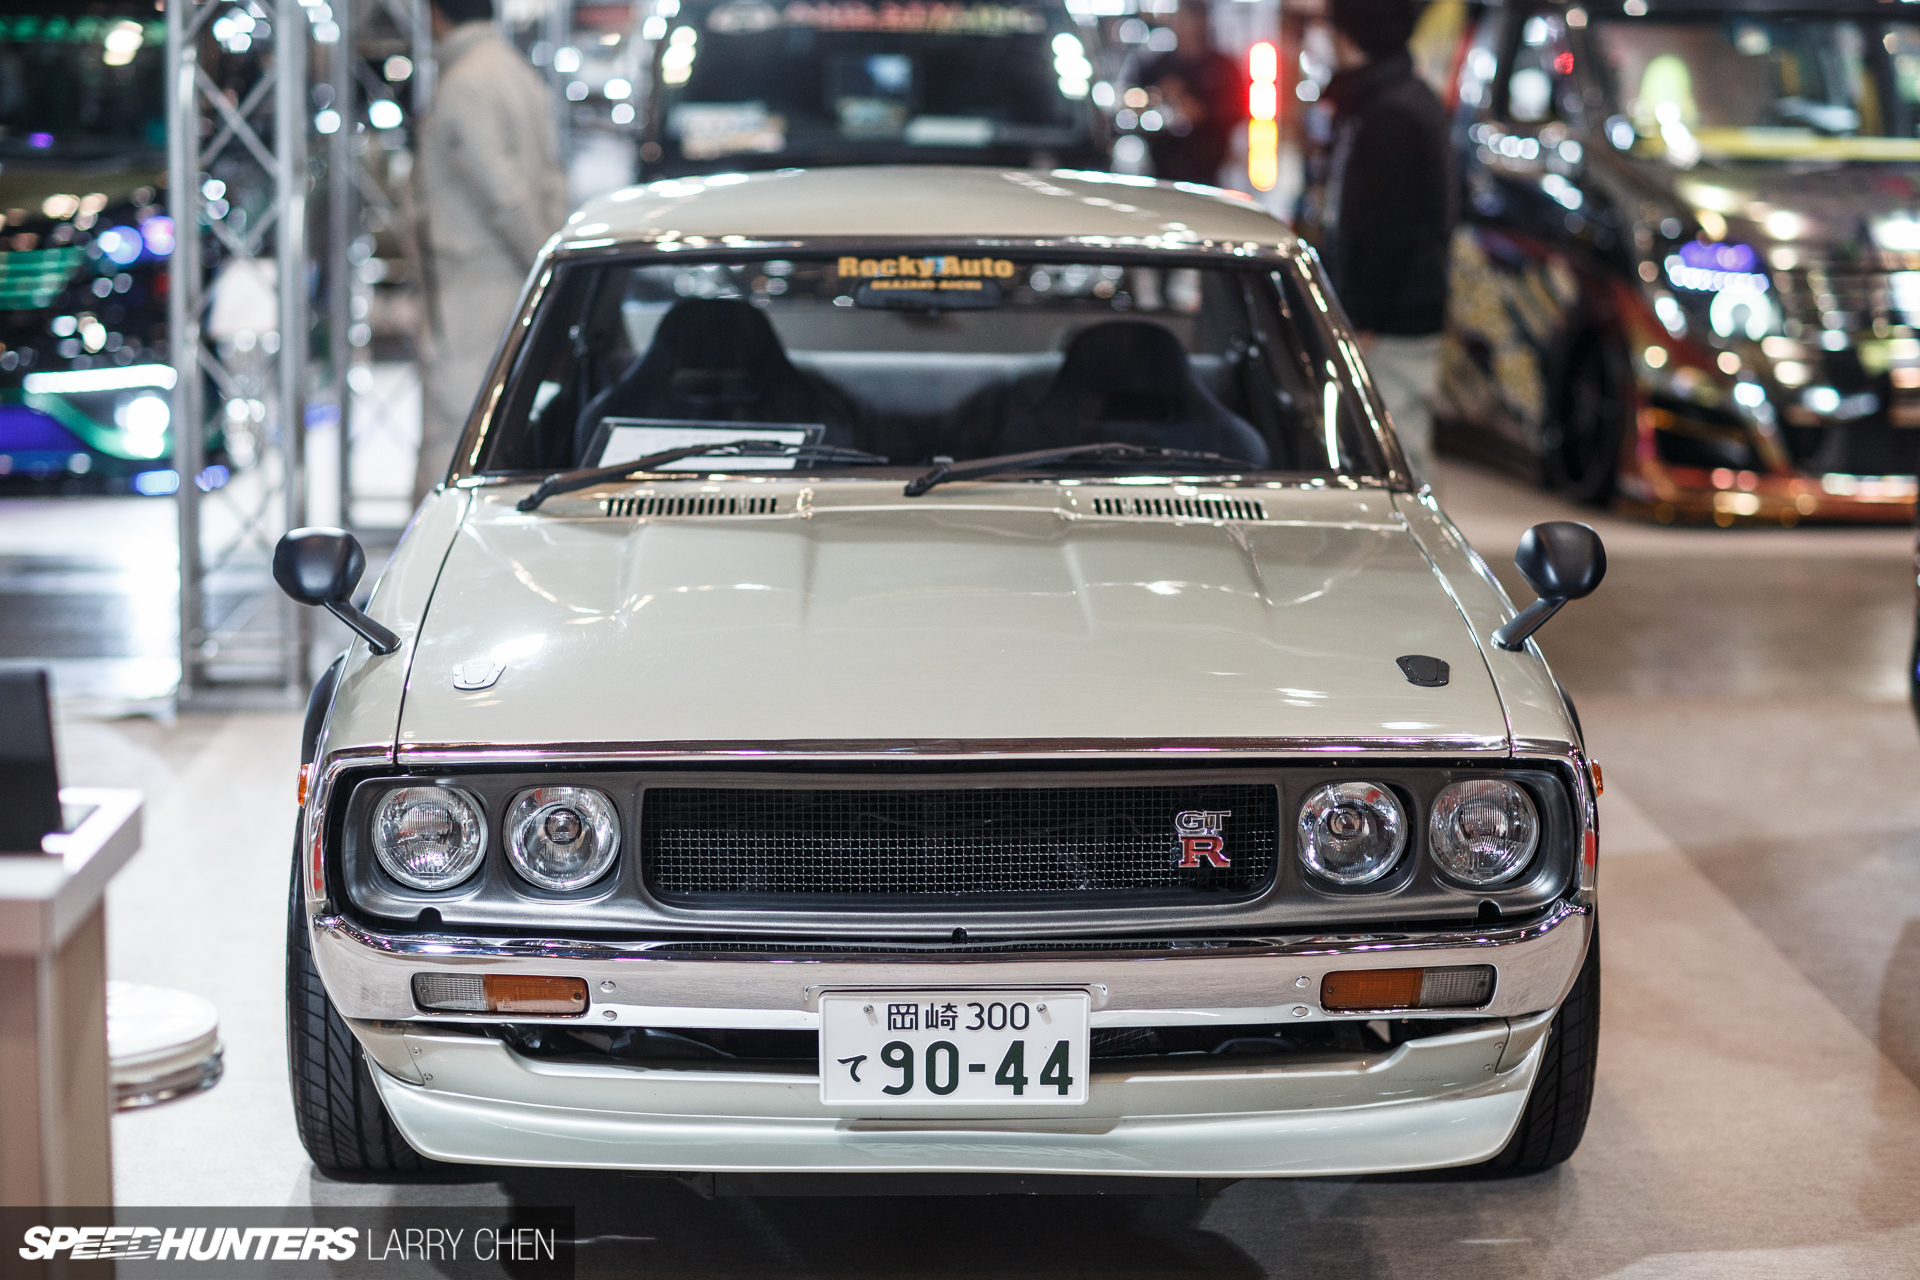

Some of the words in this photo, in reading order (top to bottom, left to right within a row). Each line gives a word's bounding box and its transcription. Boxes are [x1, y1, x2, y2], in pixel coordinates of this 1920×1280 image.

[838, 256, 935, 278] Rocky
[943, 256, 1014, 278] Auto
[1175, 810, 1231, 832] GT
[1179, 834, 1231, 868] R
